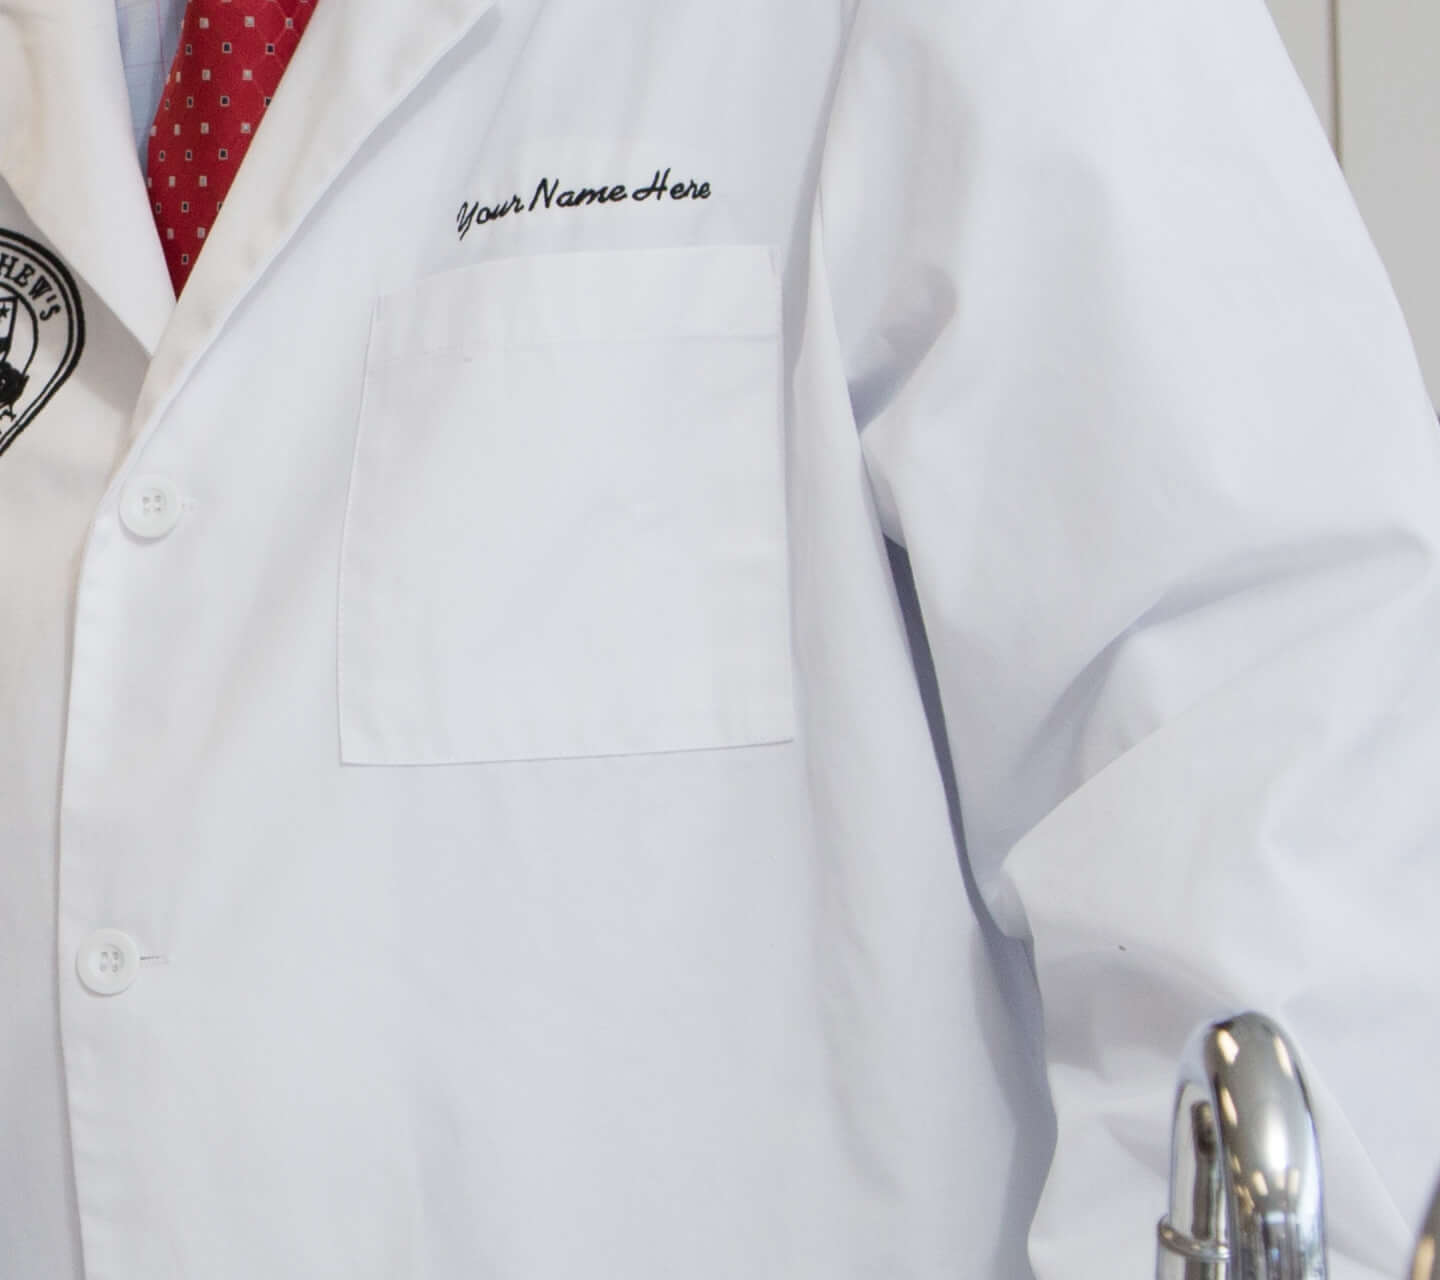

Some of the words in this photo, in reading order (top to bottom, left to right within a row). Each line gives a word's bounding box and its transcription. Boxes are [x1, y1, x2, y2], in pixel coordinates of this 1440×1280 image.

[456, 194, 524, 240] Your
[528, 177, 626, 212] Name
[632, 168, 711, 202] Here
